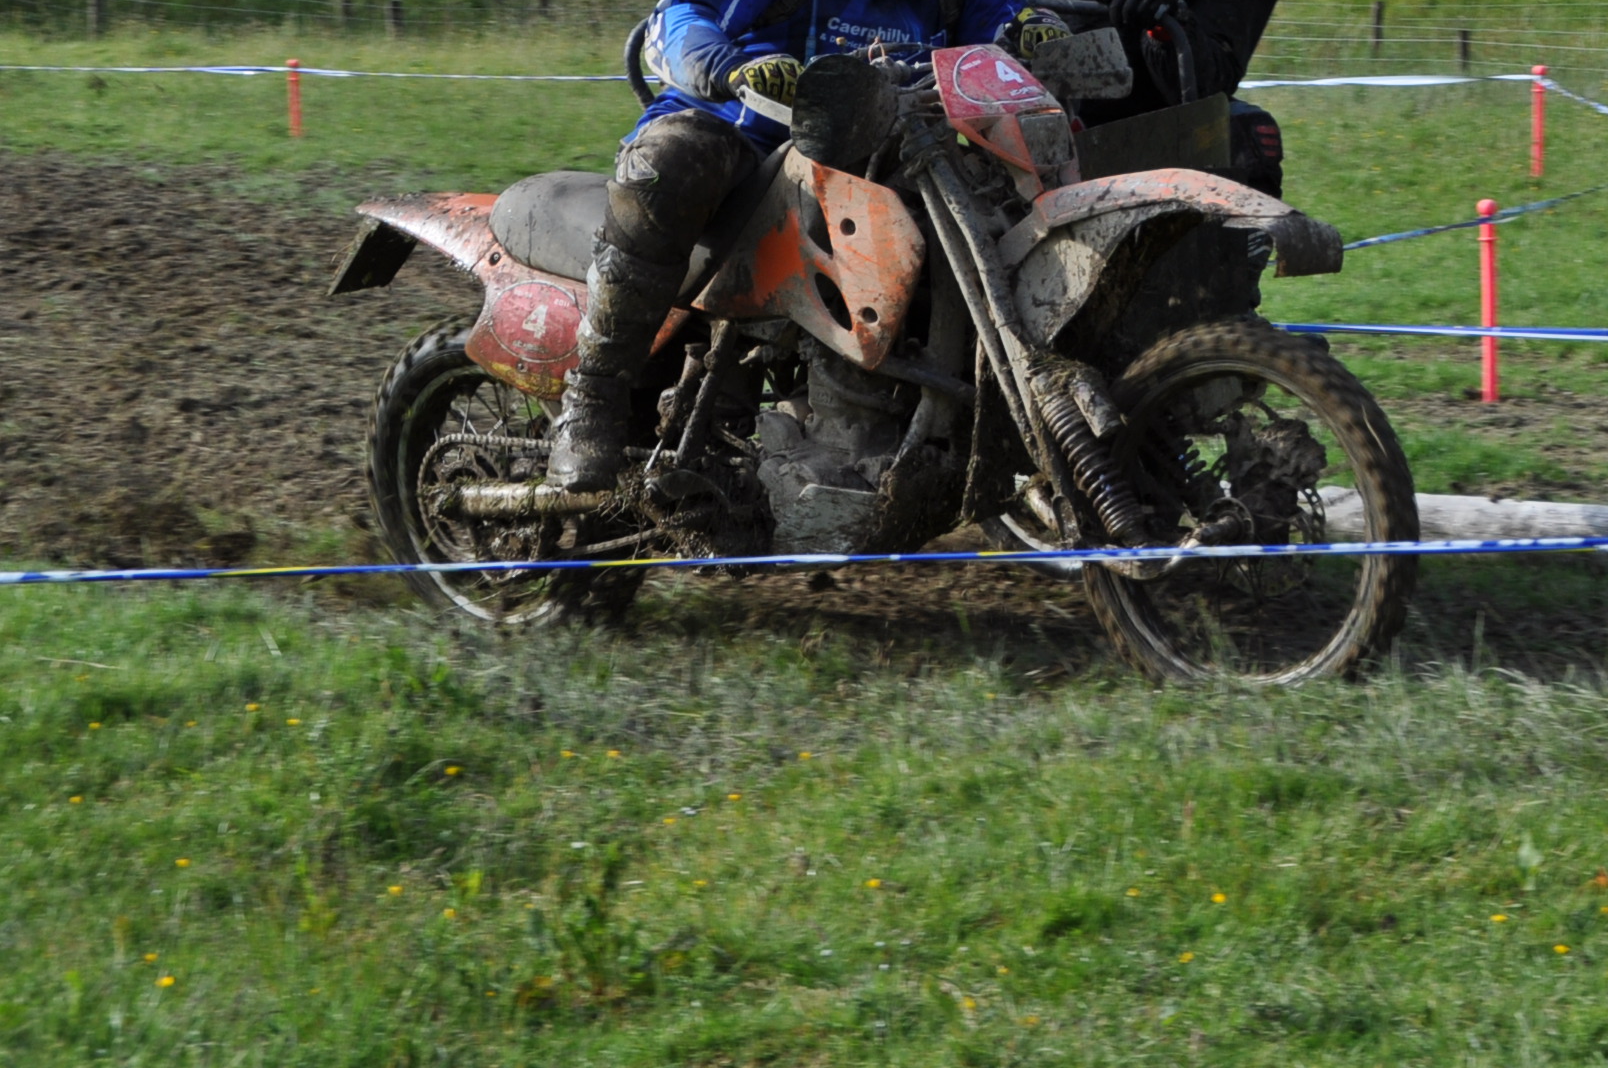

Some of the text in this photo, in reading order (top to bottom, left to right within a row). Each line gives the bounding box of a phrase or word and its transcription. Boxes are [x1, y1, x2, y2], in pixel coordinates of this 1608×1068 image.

[827, 16, 910, 43] Caerphilly
[994, 60, 1024, 84] 4
[522, 304, 548, 339] 4
